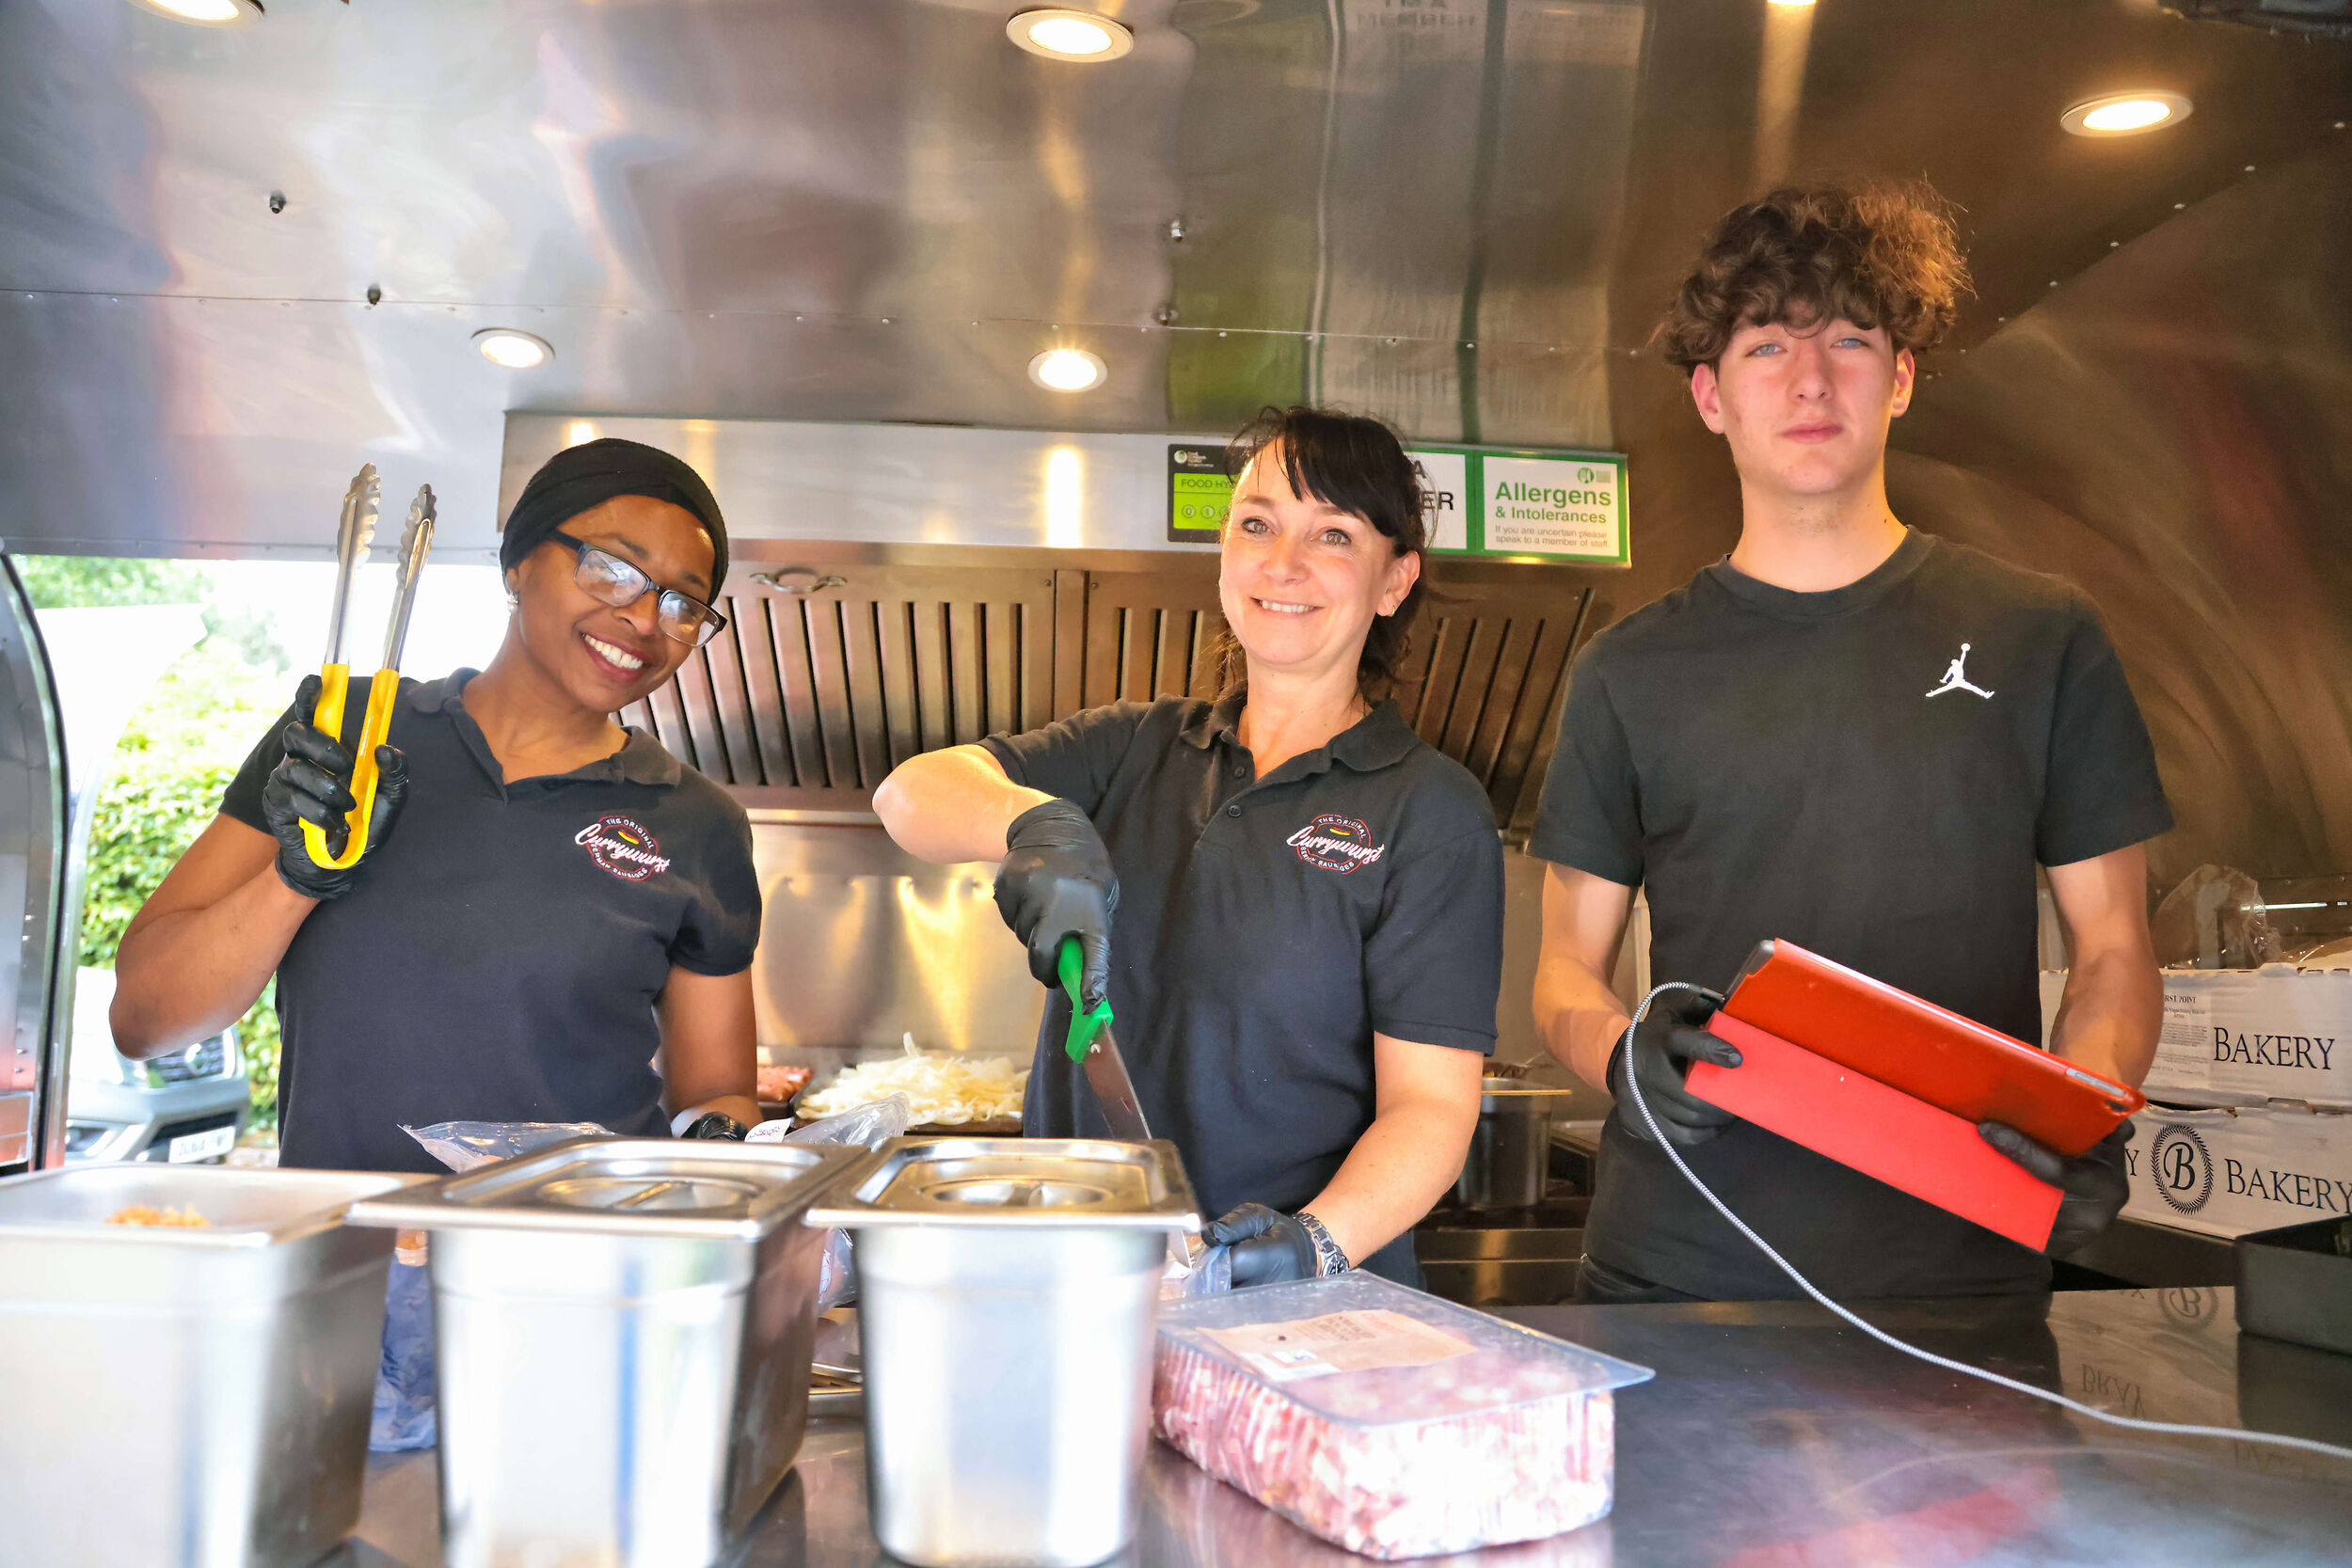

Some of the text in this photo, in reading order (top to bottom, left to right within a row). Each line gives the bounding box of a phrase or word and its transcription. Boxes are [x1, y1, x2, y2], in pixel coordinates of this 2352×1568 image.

[1182, 479, 1213, 488] FOOD
[1495, 481, 1612, 509] Allergens
[1421, 490, 1454, 511] ER
[1495, 505, 1607, 524] & Intolerances
[1496, 534, 1521, 544] speak
[1524, 535, 1533, 544] to
[1542, 537, 1578, 546] member
[1580, 538, 1588, 546] of
[1502, 527, 1519, 536] you
[1537, 528, 1577, 538] uncertain
[1579, 530, 1608, 539] please
[606, 817, 655, 849] THE ORIGINAL
[1336, 818, 1367, 839] ORIGINAL
[574, 823, 671, 873] Currywurst
[1286, 825, 1385, 864] Currywurst
[2164, 994, 2177, 1005] RST
[2213, 1026, 2335, 1070] BAKERY
[2124, 1148, 2139, 1177] Y
[2163, 1141, 2197, 1191] B
[2224, 1158, 2352, 1214] BAKERY
